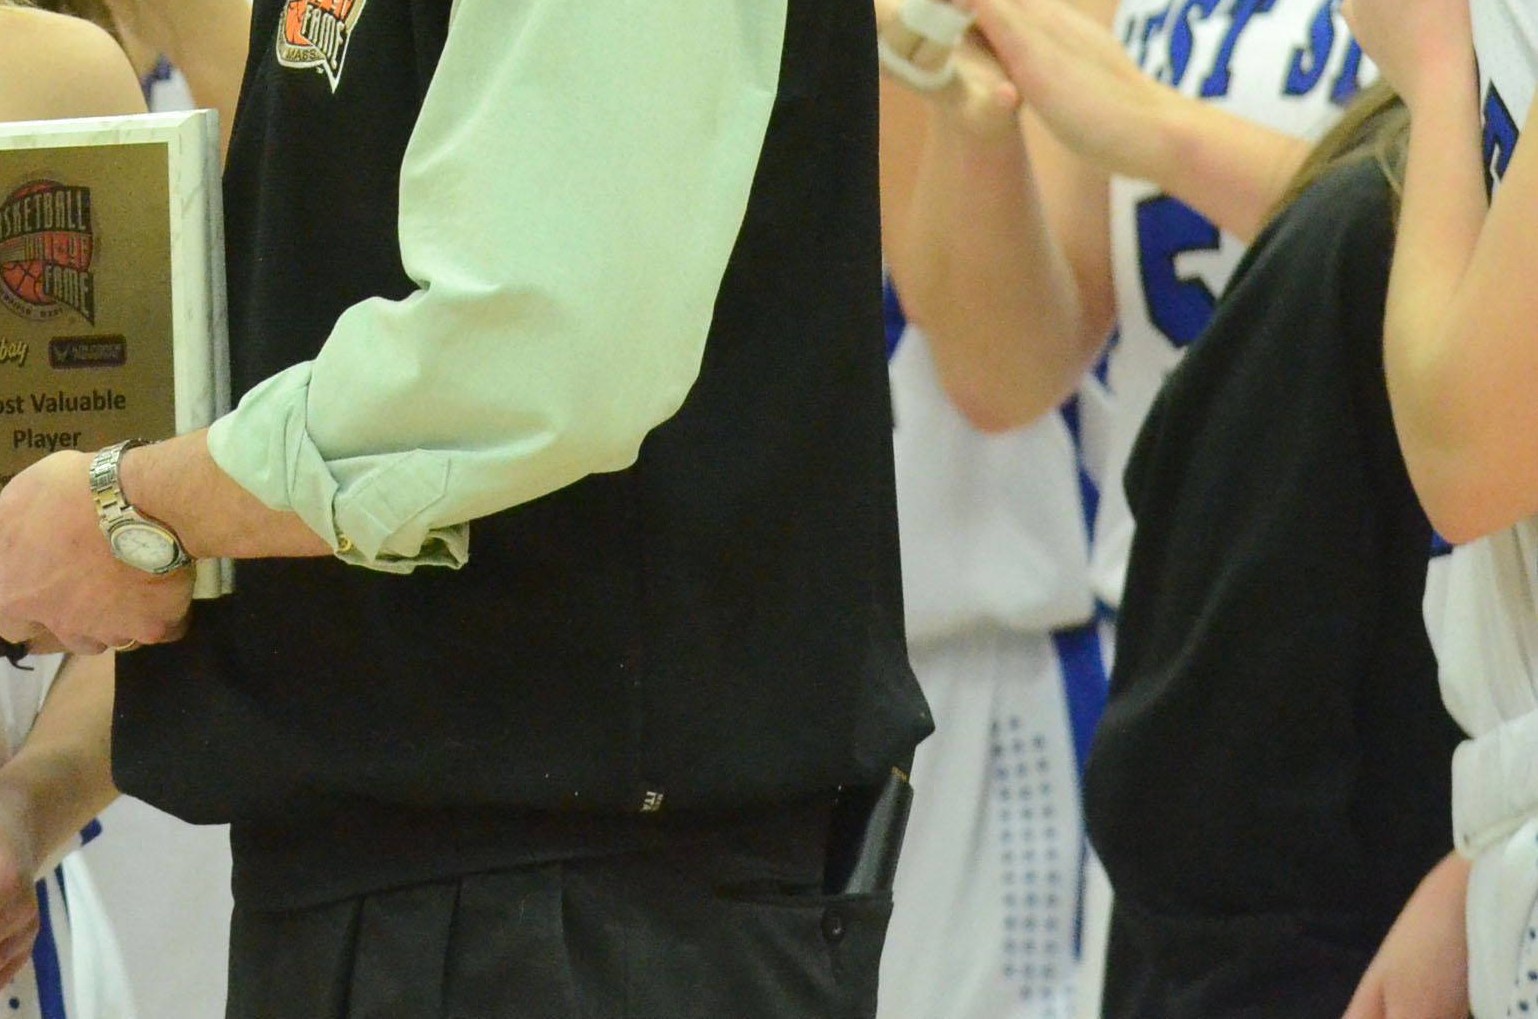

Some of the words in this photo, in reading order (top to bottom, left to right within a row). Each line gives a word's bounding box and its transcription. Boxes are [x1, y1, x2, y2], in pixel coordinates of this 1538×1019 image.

[302, 2, 346, 70] FAME
[45, 263, 90, 319] FAME
[30, 390, 126, 413] Valuable
[13, 429, 82, 452] Player
